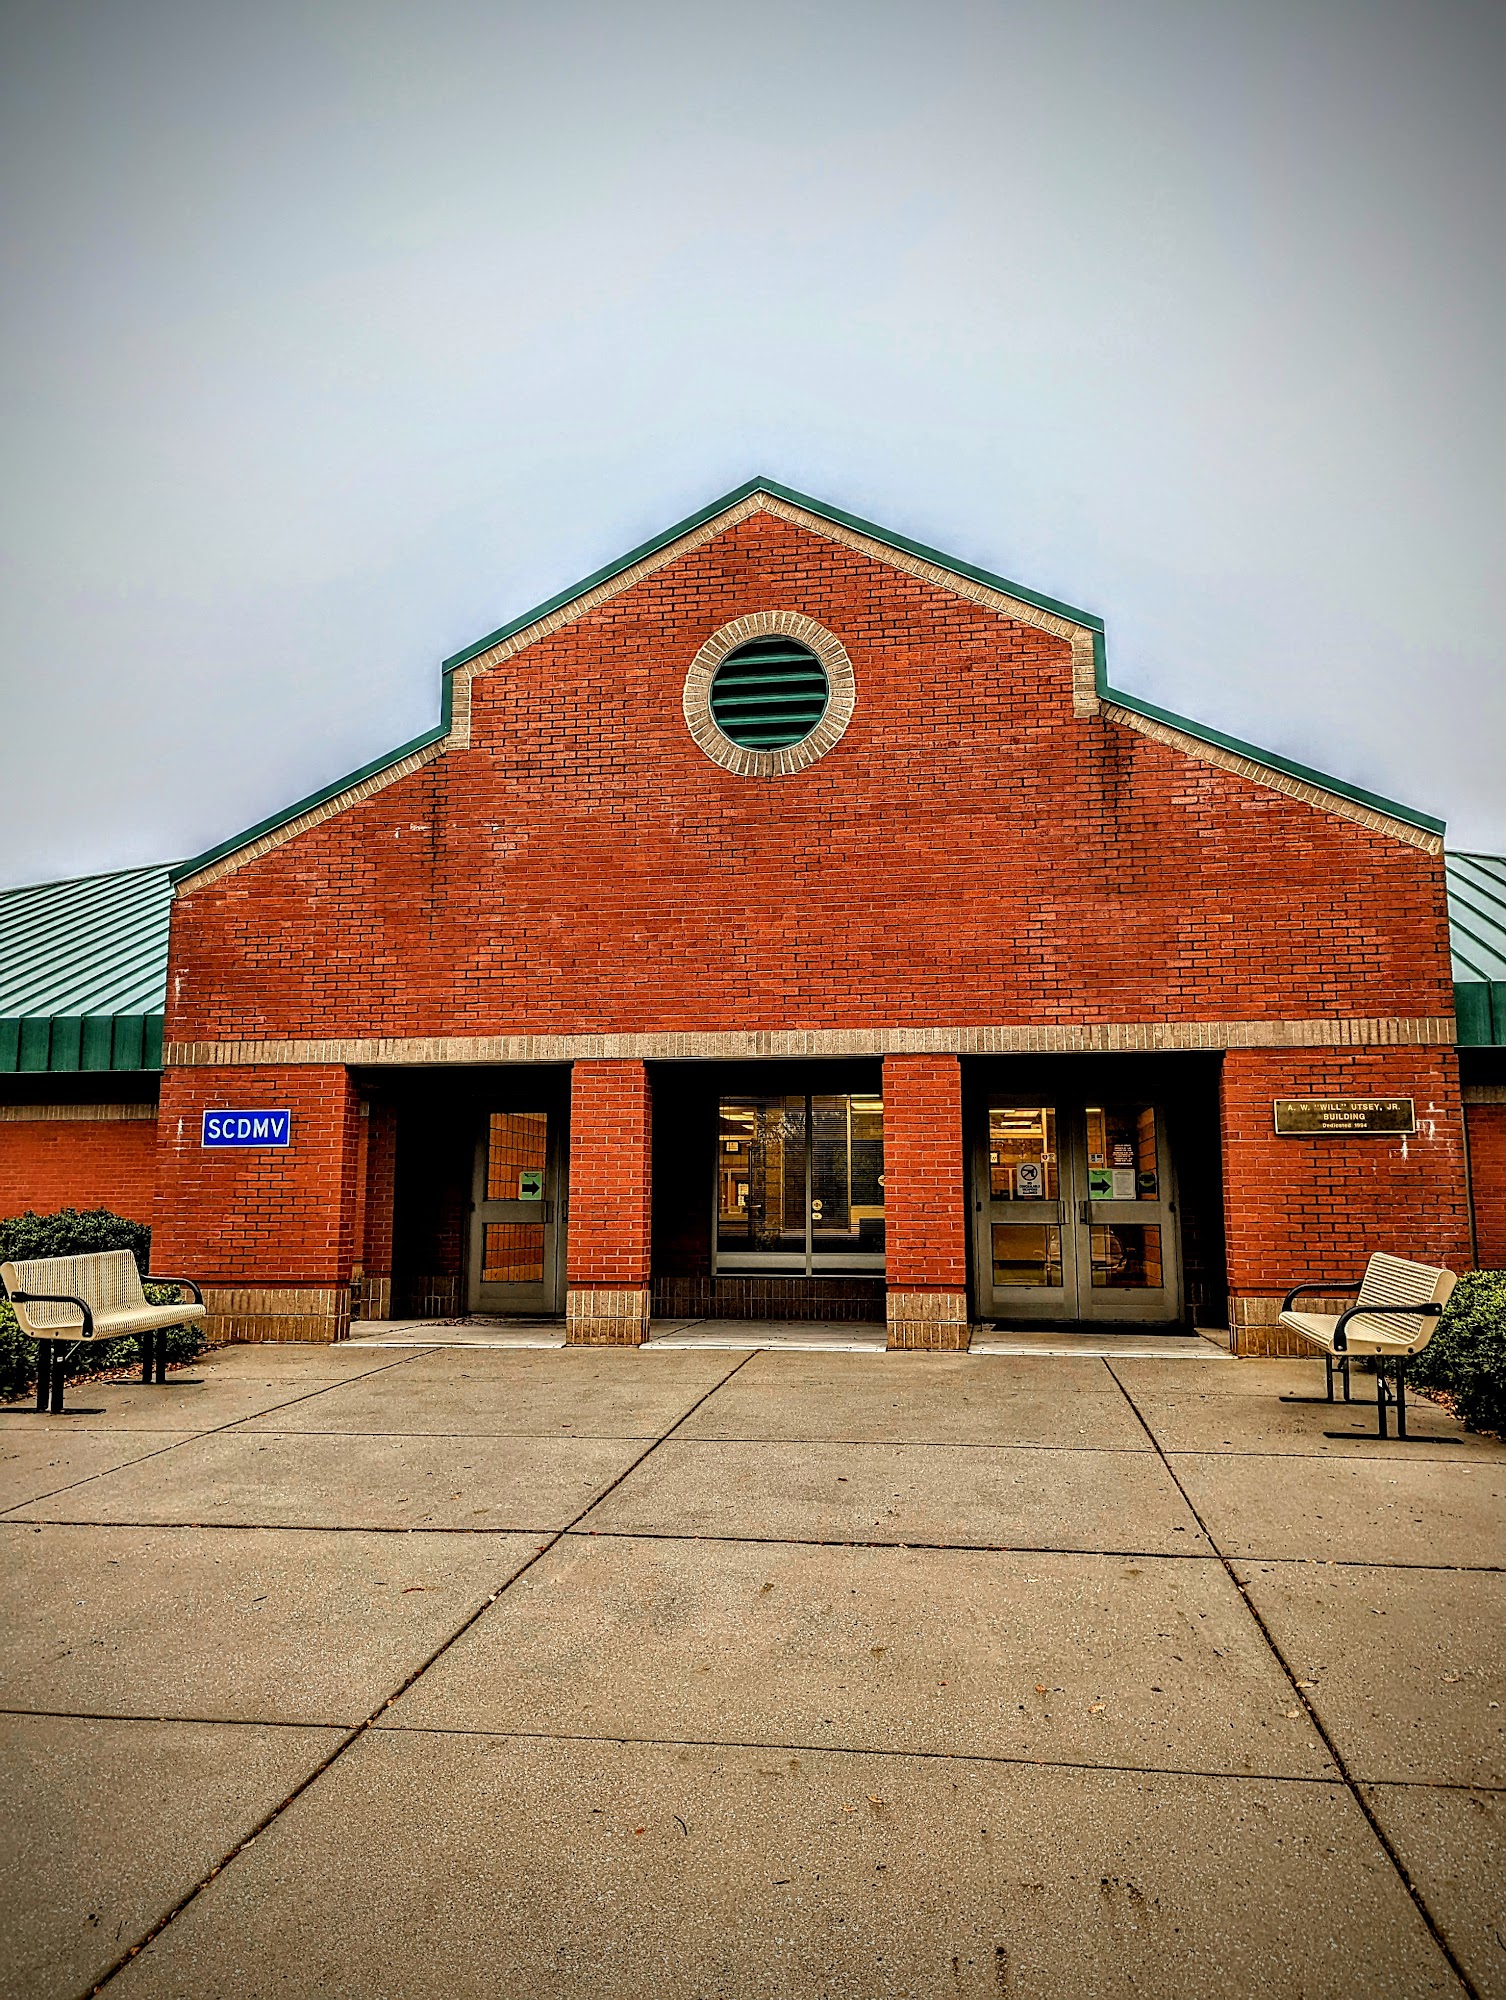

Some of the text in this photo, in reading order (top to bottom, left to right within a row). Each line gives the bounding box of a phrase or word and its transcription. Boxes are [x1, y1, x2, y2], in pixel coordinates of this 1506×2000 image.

[1351, 1103, 1383, 1111] UTSEY,
[1387, 1103, 1401, 1111] JR.
[207, 1118, 285, 1139] SCDMV
